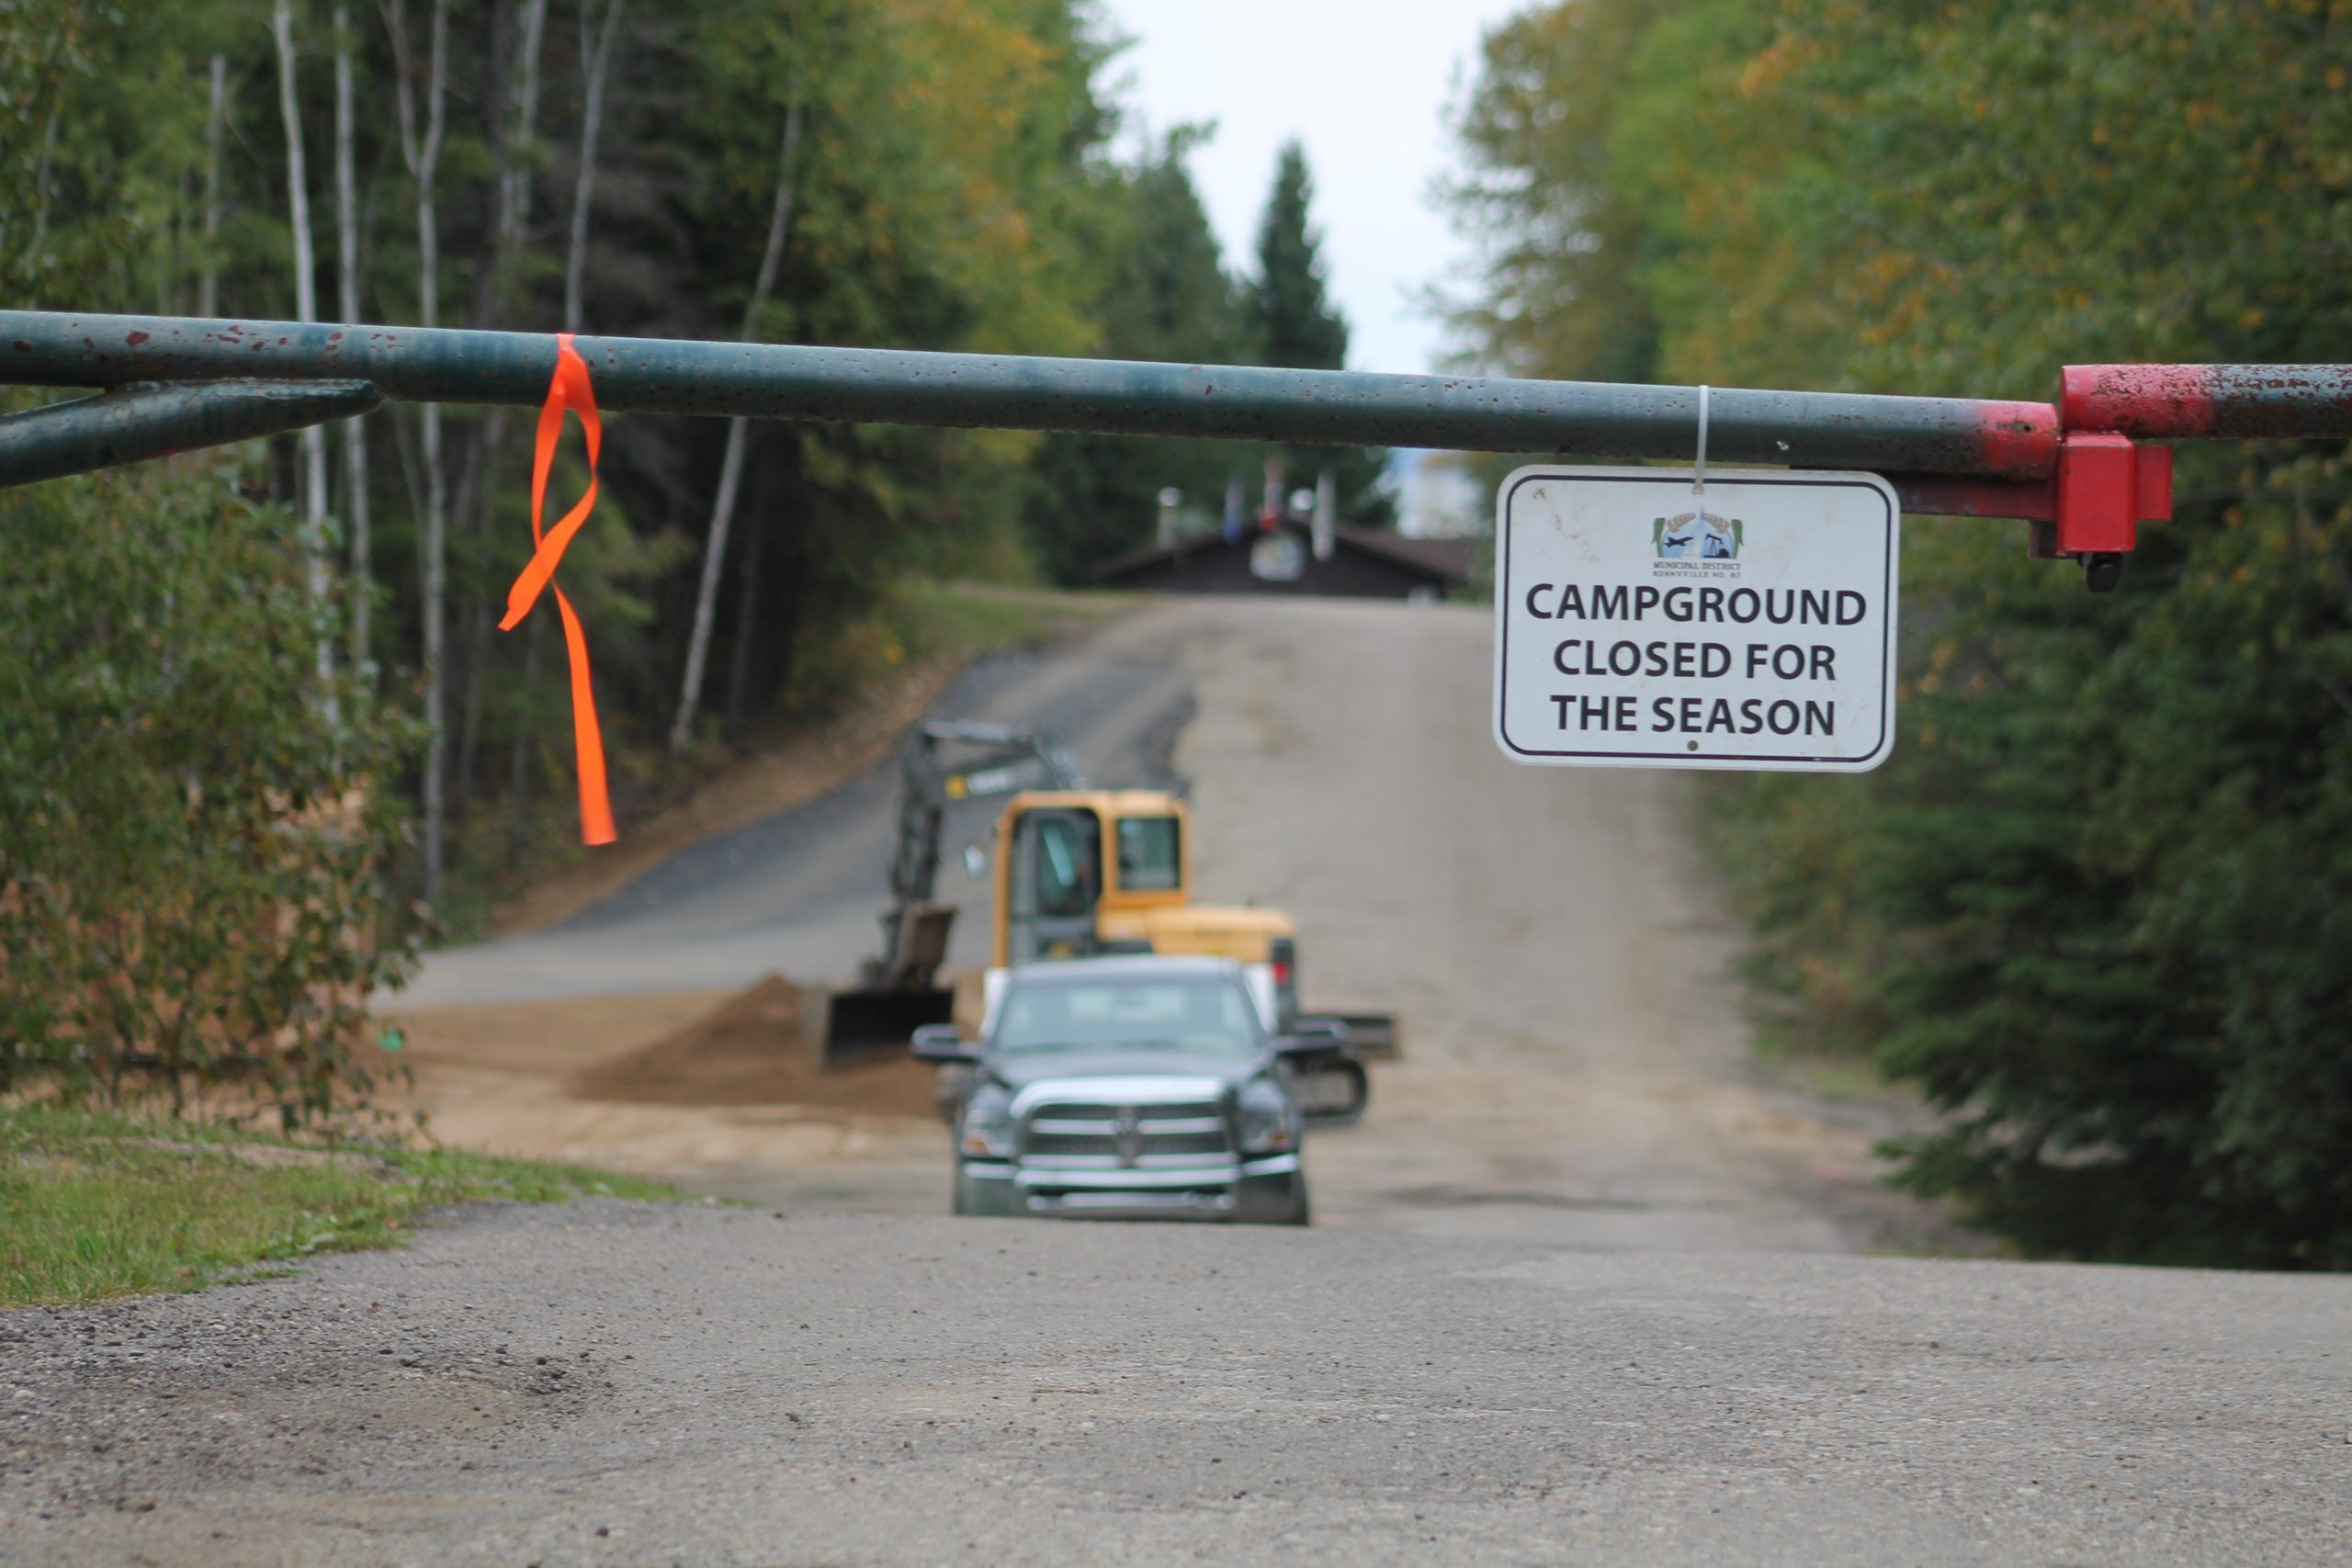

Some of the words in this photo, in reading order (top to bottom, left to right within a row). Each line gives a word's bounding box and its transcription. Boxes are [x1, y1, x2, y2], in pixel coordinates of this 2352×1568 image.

[1653, 561, 1699, 570] MUNICIPAL
[1702, 562, 1741, 570] DISTRICT
[1526, 582, 1867, 626] CAMPGROUND
[1554, 638, 1732, 679] CLOSED
[1746, 643, 1837, 681] FOR
[1550, 694, 1638, 732] THE
[1651, 696, 1835, 736] SEASON
